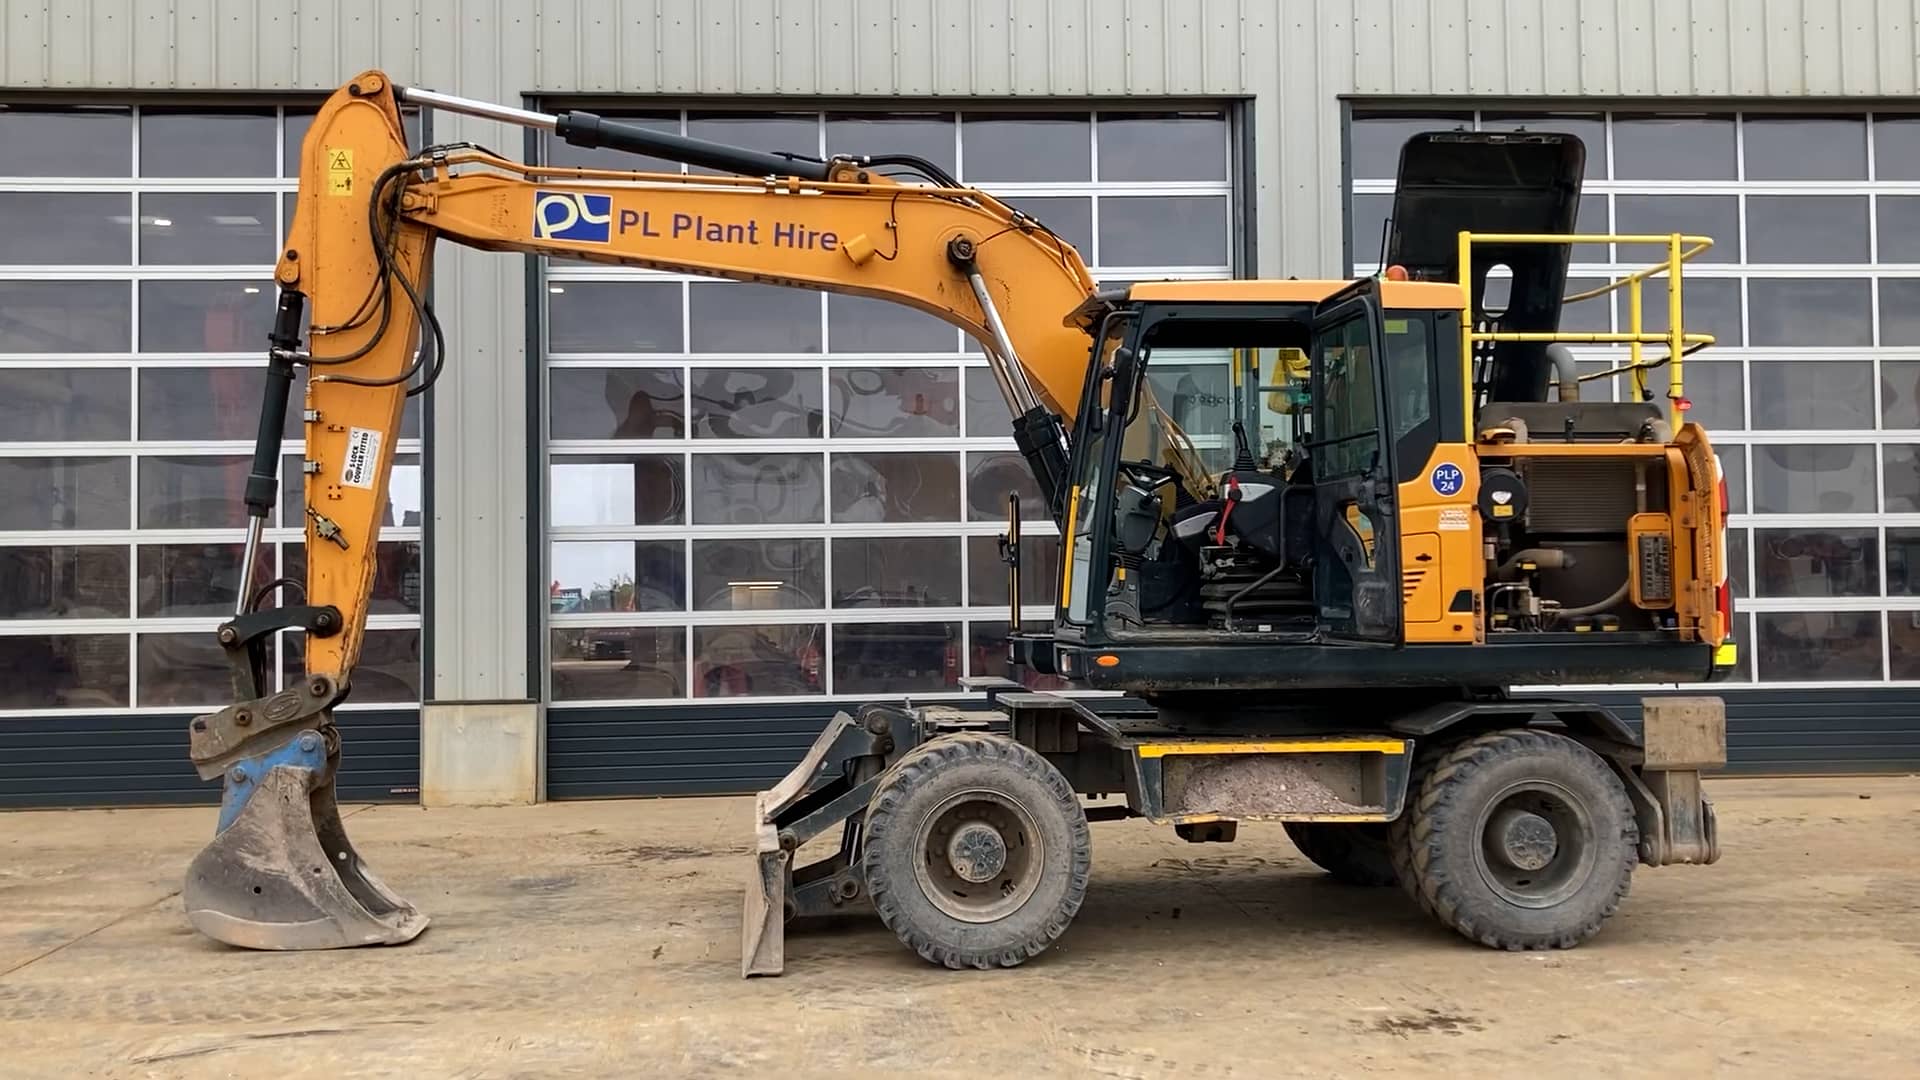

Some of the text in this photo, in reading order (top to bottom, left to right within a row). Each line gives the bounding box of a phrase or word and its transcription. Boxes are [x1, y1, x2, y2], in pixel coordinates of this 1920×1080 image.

[620, 209, 838, 251] PL Plant Hire
[353, 432, 368, 483] COUPLER FITTED
[1436, 470, 1459, 480] PLP
[1440, 481, 1455, 492] 24
